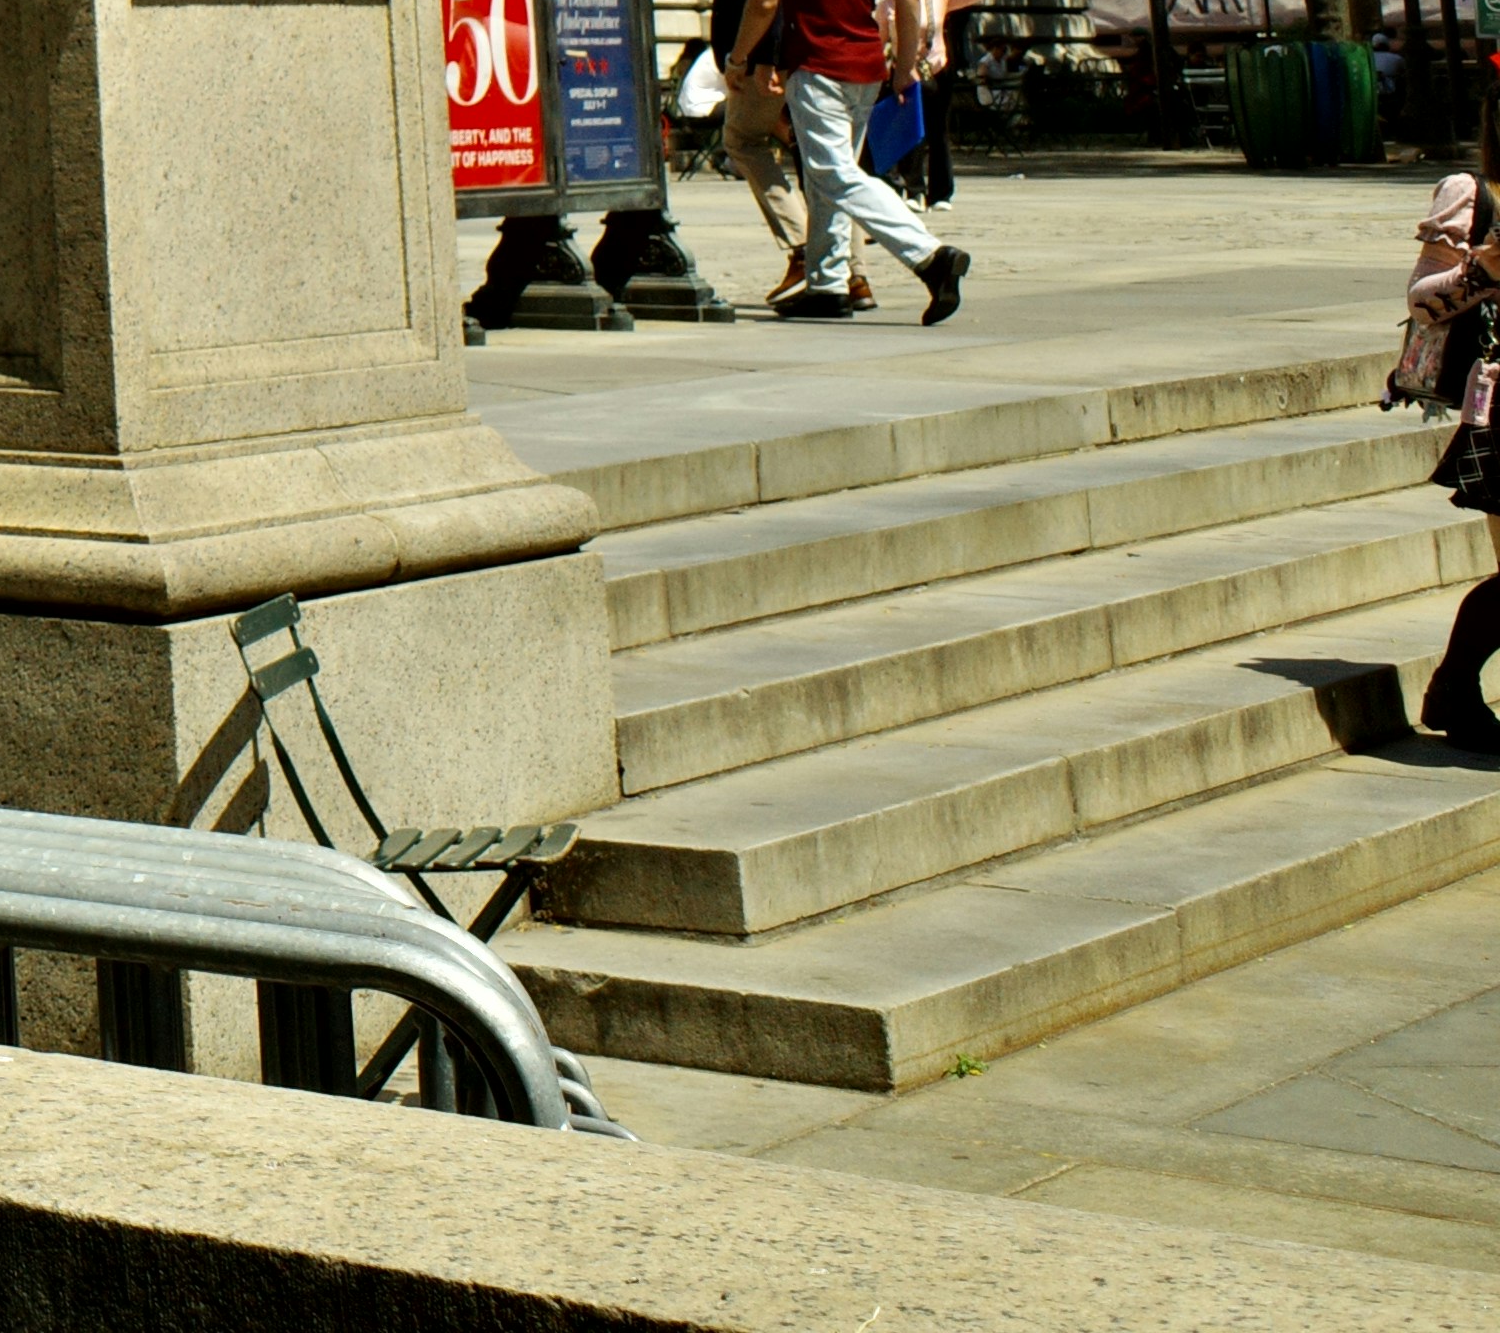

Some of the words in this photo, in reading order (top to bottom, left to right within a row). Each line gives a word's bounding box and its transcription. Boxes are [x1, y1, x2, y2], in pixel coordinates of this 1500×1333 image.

[489, 127, 512, 144] AND
[512, 126, 533, 144] THE
[462, 150, 477, 169] OF
[477, 148, 534, 167] HAPPINESS
